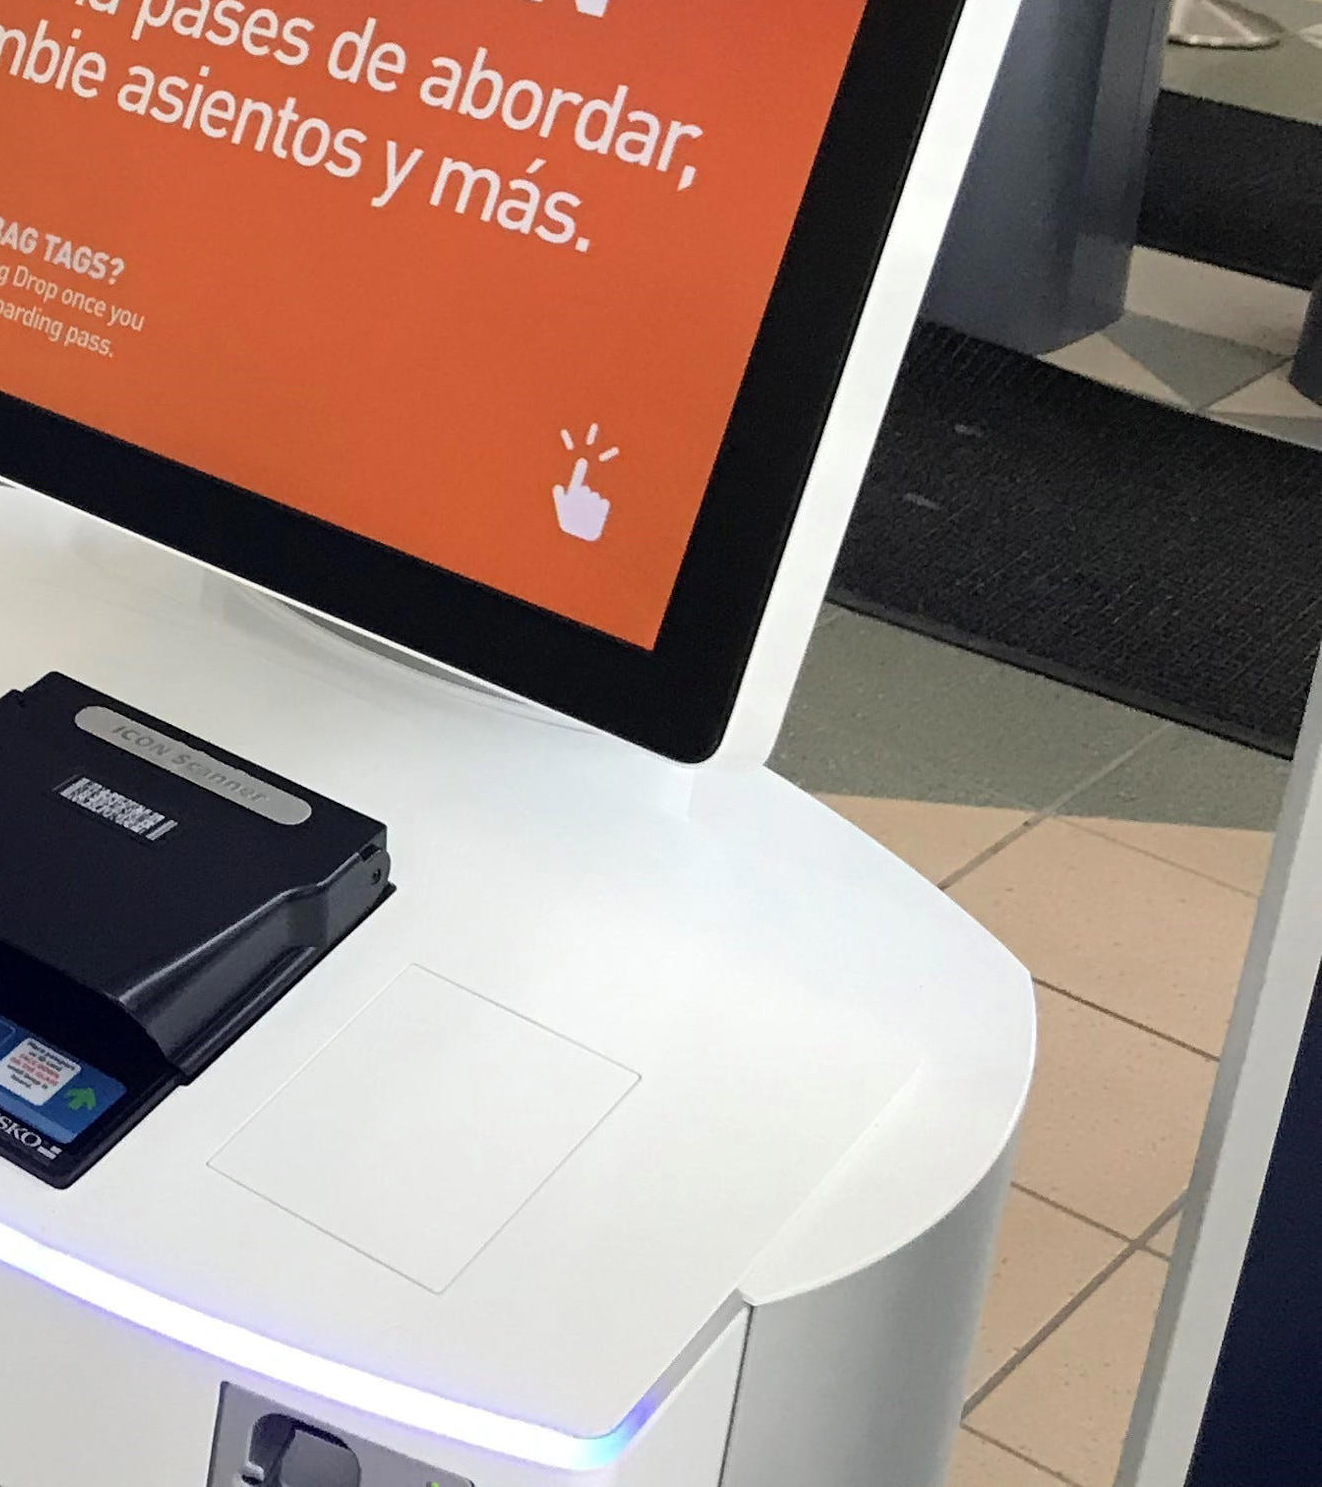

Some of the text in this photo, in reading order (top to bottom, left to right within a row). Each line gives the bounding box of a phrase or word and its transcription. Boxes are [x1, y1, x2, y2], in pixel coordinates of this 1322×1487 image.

[327, 17, 407, 92] de
[419, 47, 704, 192] abordar,
[117, 65, 368, 178] asientos
[371, 140, 425, 207] y
[429, 158, 591, 253] más.
[42, 233, 125, 286] TAGS?
[12, 265, 59, 304] Drop
[61, 287, 107, 317] once
[106, 302, 146, 332] you
[64, 325, 115, 359] pass.
[112, 725, 270, 803] ICON Scanner
